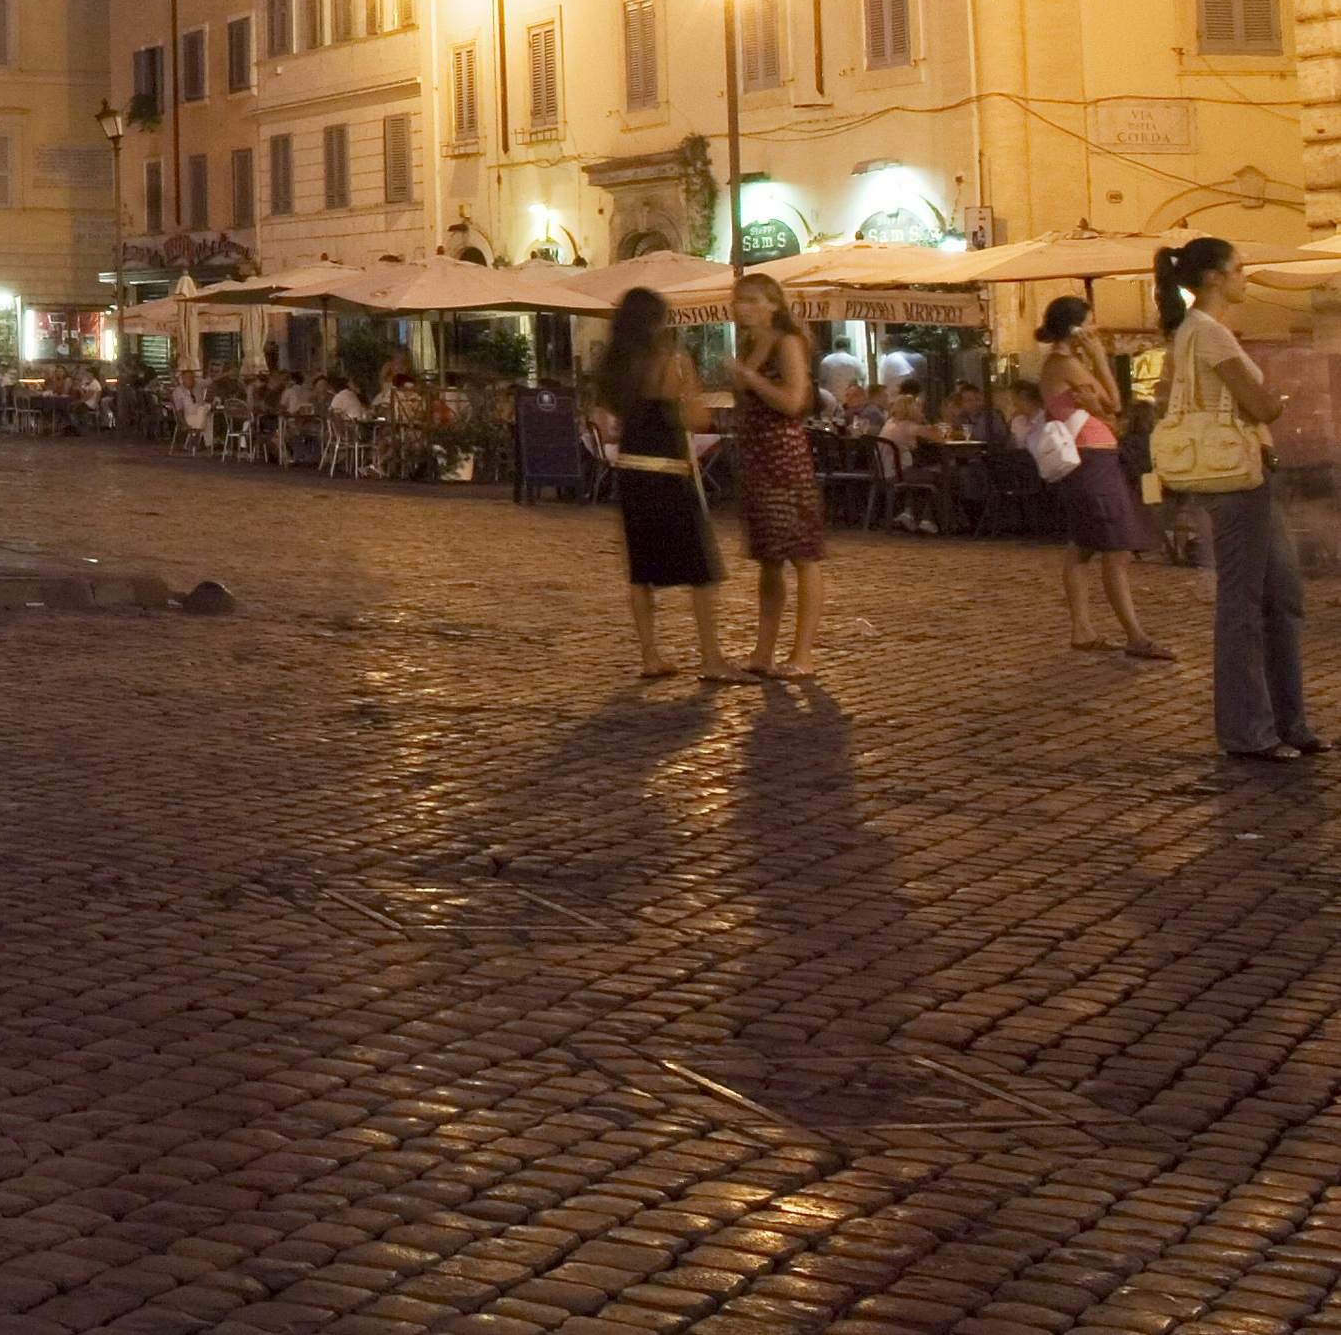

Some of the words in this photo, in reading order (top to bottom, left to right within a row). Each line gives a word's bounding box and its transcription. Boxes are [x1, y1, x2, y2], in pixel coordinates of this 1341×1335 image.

[1131, 110, 1153, 120] VIA
[667, 303, 731, 325] RISTORA
[844, 300, 896, 320] PIZZERIA
